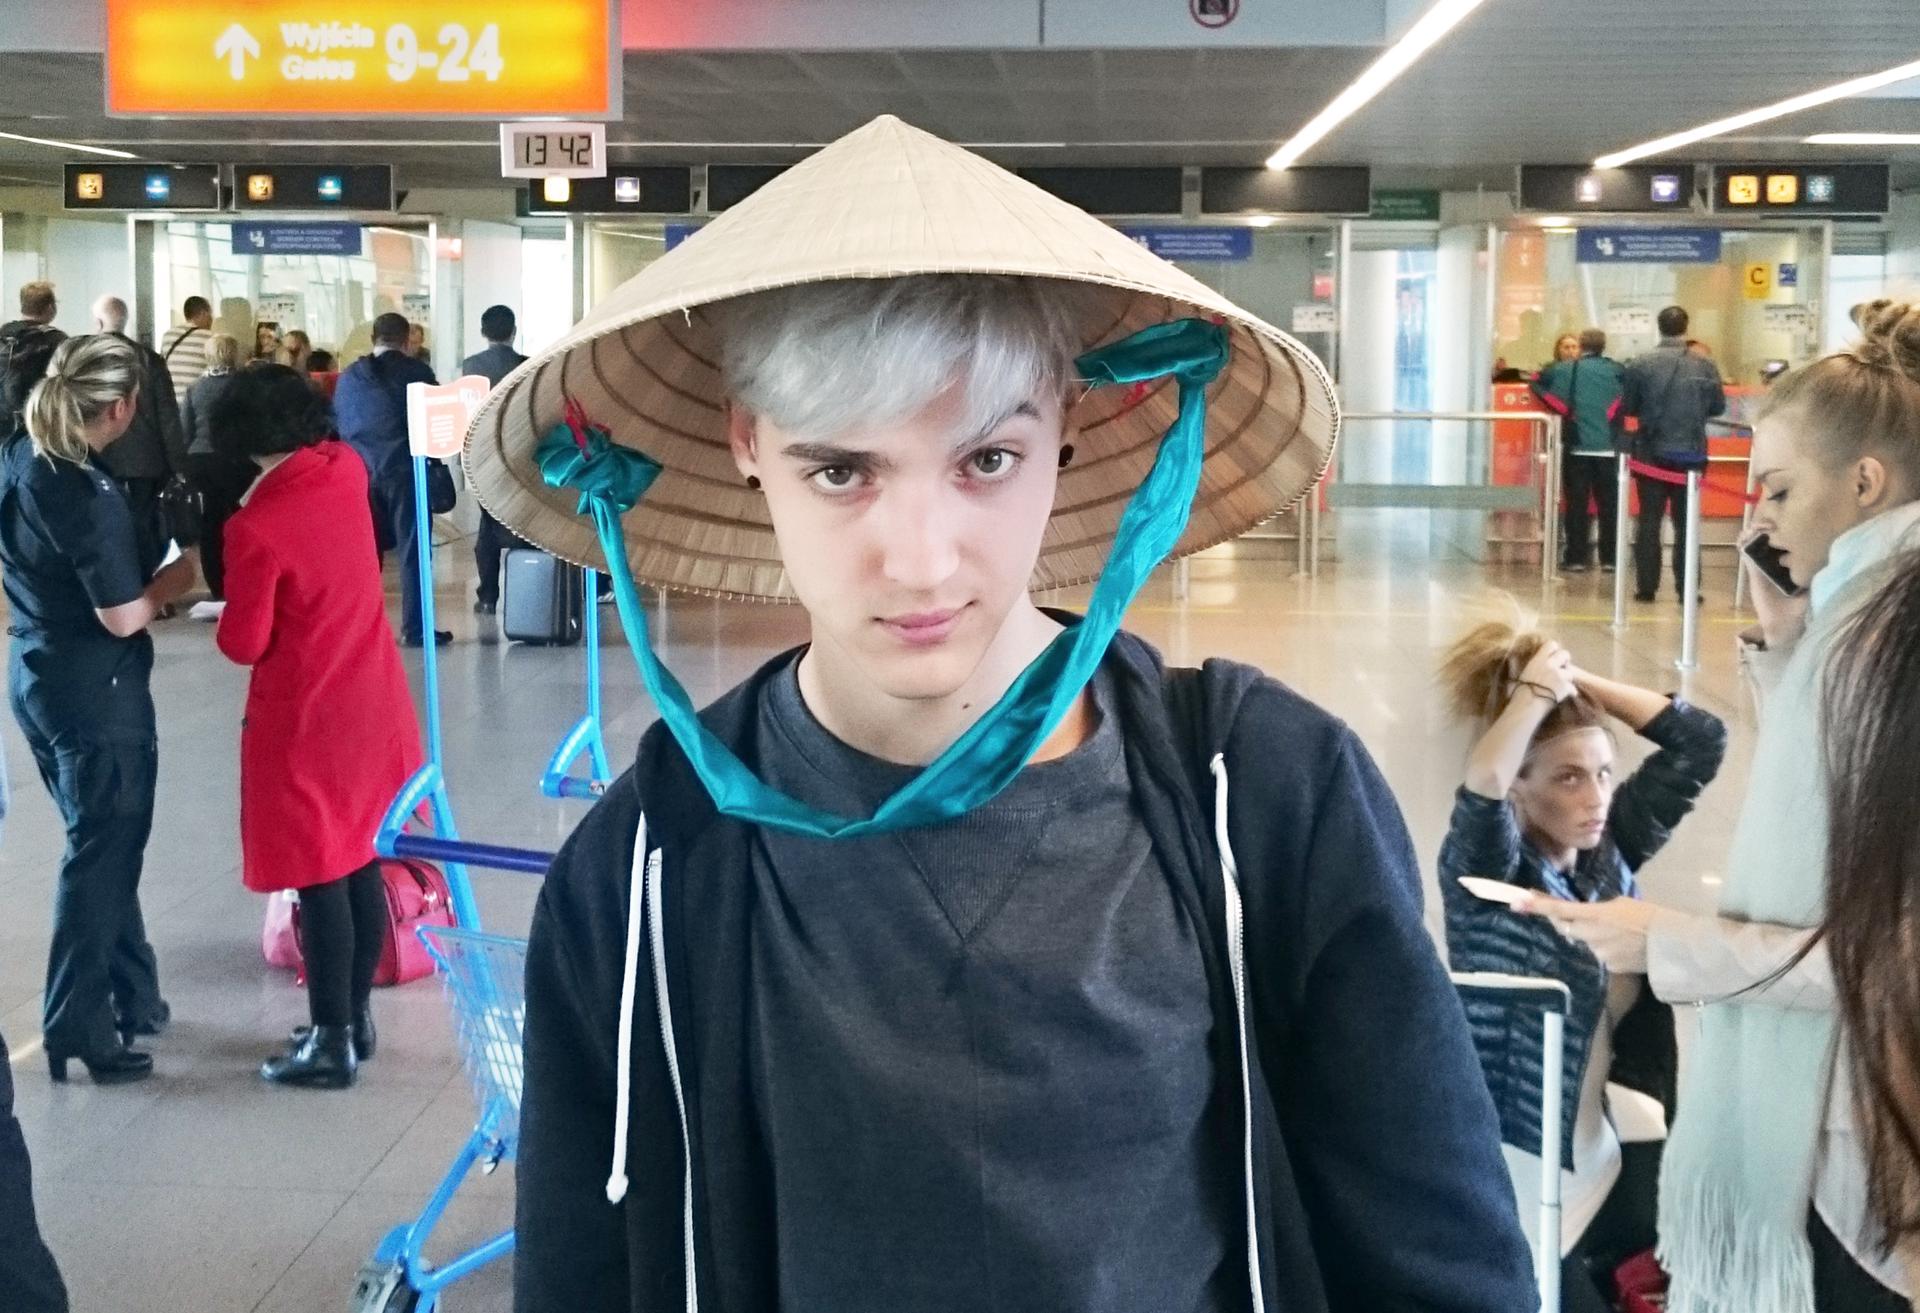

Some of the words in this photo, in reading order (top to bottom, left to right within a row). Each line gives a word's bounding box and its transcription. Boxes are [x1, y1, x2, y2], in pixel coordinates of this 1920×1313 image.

[385, 22, 503, 81] 9-24
[281, 54, 355, 80] Gates
[526, 135, 547, 166] 13
[560, 135, 591, 166] 42
[1750, 267, 1764, 286] C
